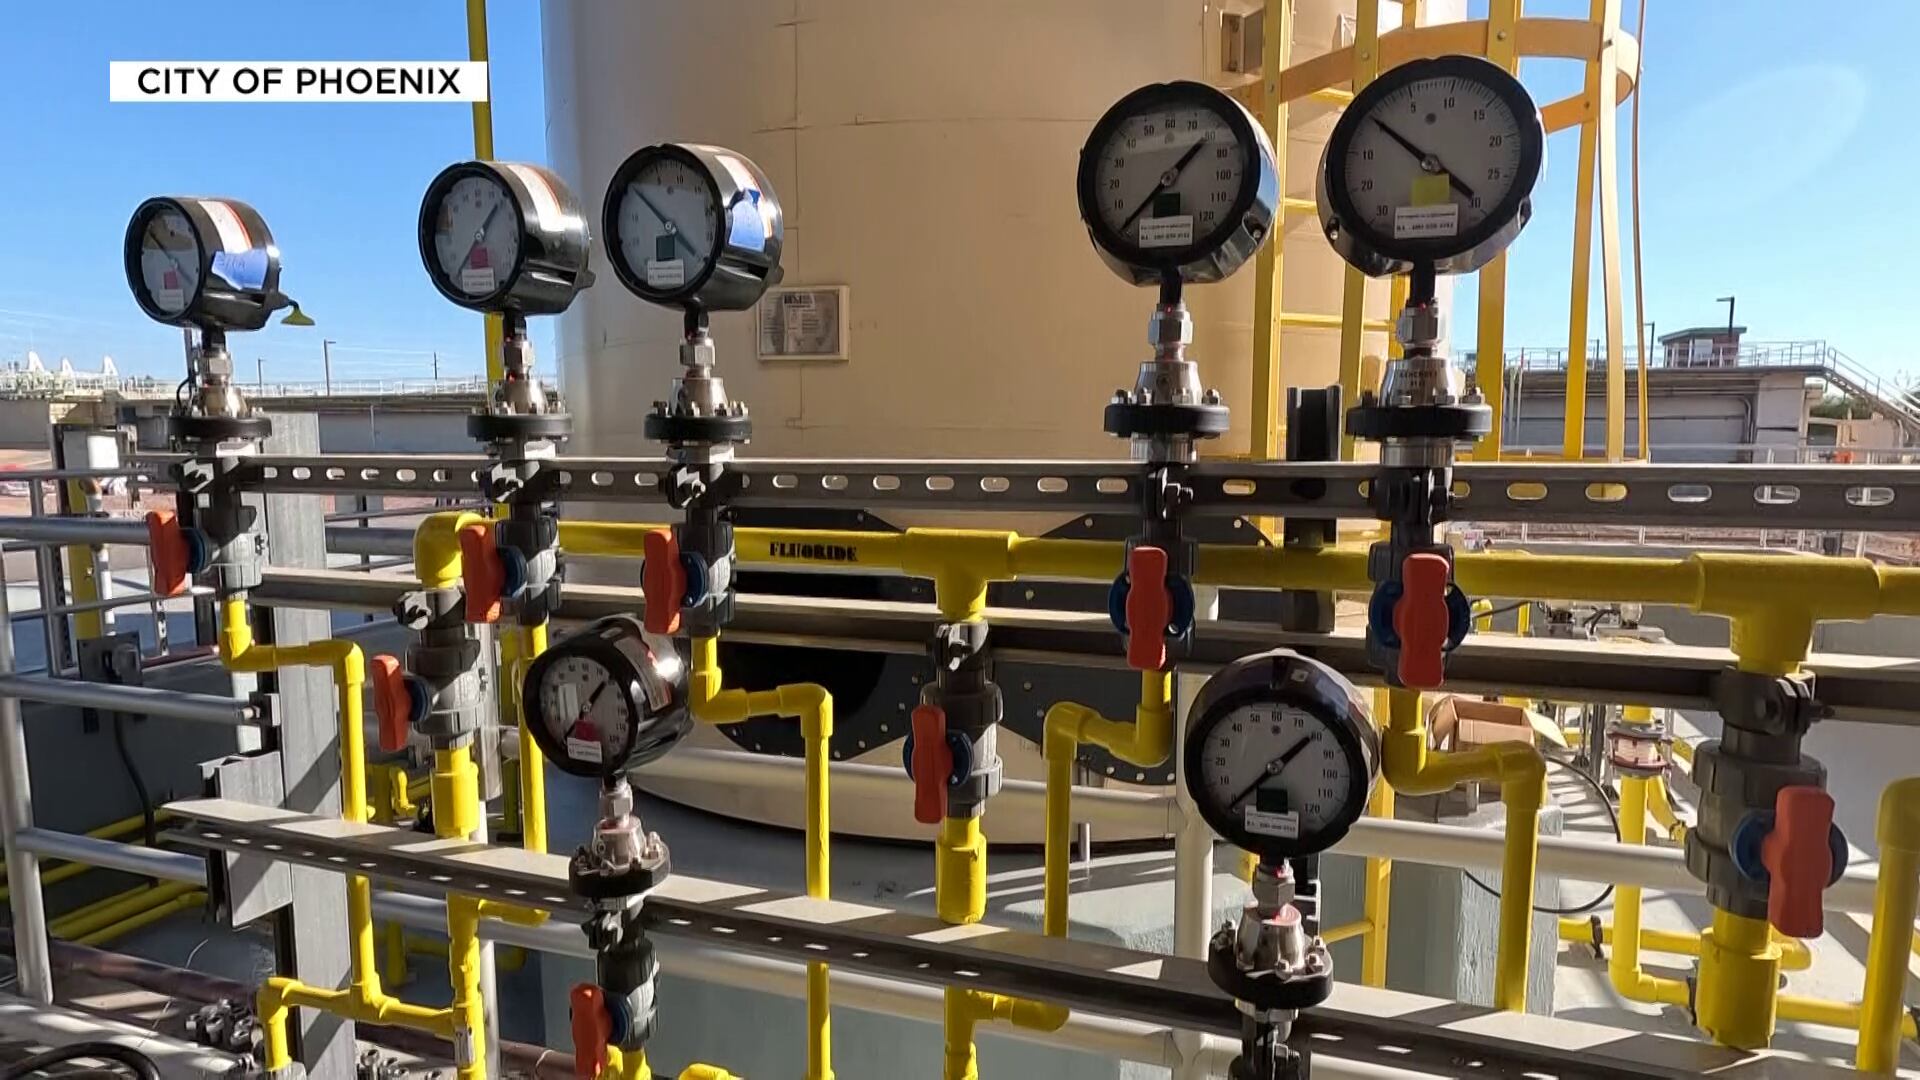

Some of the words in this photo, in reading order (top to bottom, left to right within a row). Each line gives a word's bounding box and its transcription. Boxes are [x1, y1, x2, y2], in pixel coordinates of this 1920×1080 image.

[1444, 97, 1455, 108] 10
[1473, 109, 1485, 121] 15
[1165, 119, 1176, 129] 60
[1187, 120, 1198, 130] 70
[1144, 124, 1155, 136] 50
[1126, 138, 1137, 149] 40
[1489, 135, 1502, 147] 20
[1362, 149, 1374, 160] 10
[1114, 158, 1124, 168] 30
[1216, 170, 1231, 181] 100
[1487, 168, 1500, 180] 25
[1109, 178, 1120, 189] 20
[1361, 180, 1373, 191] 20
[1211, 192, 1227, 203] 110
[1114, 199, 1124, 209] 10
[1199, 210, 1214, 221] 120
[1376, 205, 1389, 216] 30
[770, 542, 858, 561] FLUORIDE
[1250, 714, 1261, 724] 50
[1271, 711, 1282, 722] 60
[1232, 723, 1242, 733] 40
[1293, 718, 1304, 728] 70
[1220, 738, 1230, 748] 30
[1323, 750, 1335, 760] 90
[1215, 757, 1226, 766] 20
[1322, 769, 1338, 779] 100
[1220, 775, 1230, 785] 10
[1317, 787, 1333, 798] 110
[1304, 803, 1320, 813] 120
